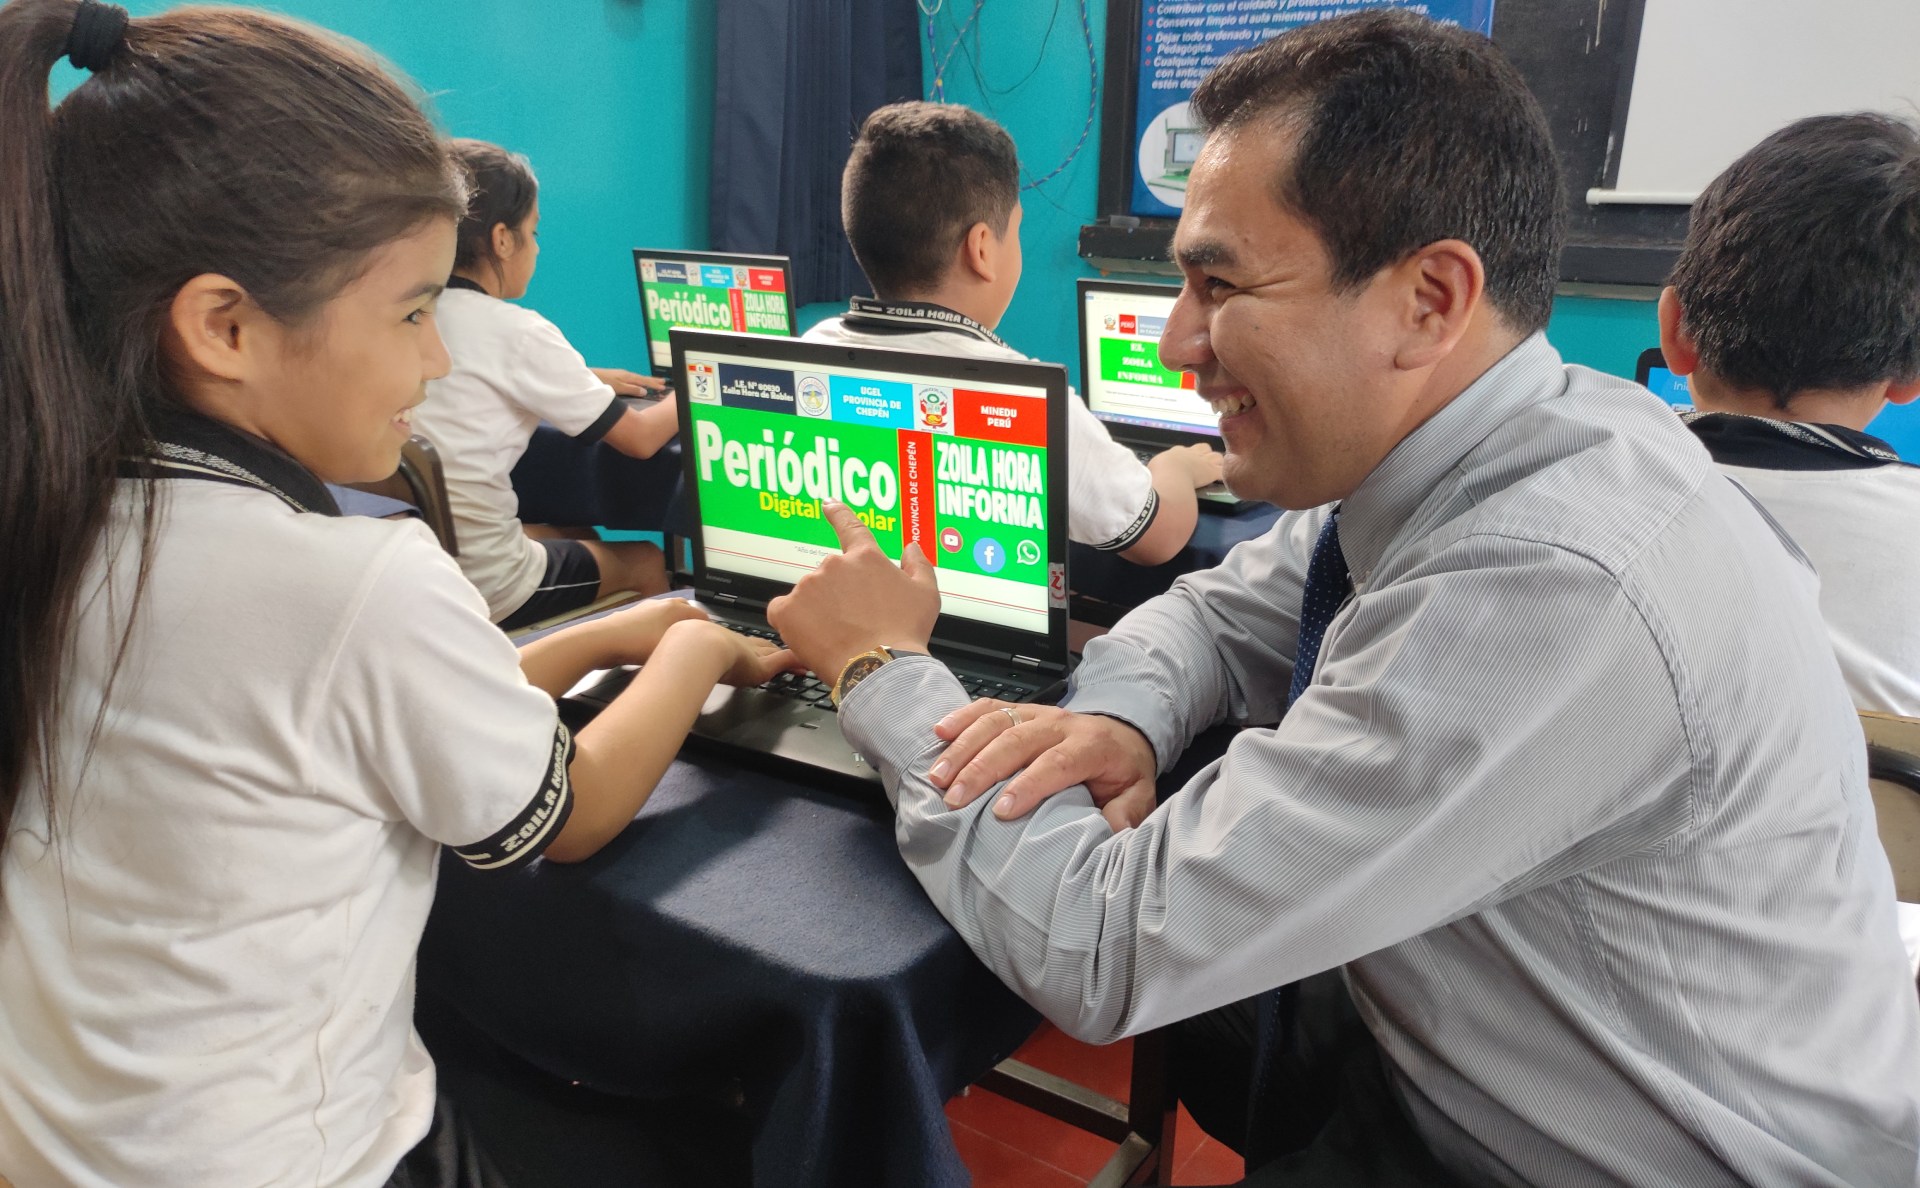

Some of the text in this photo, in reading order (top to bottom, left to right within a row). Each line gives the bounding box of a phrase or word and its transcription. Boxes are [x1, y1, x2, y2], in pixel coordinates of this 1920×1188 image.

[1157, 3, 1205, 15] Contribuir
[1206, 3, 1226, 13] con
[1226, 1, 1237, 11] el
[1237, 0, 1277, 11] cuidado
[1278, 0, 1287, 10] y
[1156, 17, 1205, 29] Conservar
[1206, 15, 1238, 28] limpio
[1238, 13, 1249, 25] el
[1249, 12, 1271, 24] aula
[1271, 10, 1318, 23] mientras
[1155, 32, 1181, 44] Dejar
[1182, 31, 1204, 42] todo
[1204, 29, 1252, 41] ordenado
[1253, 30, 1262, 41] y
[1153, 55, 1200, 68] Cualquier
[1155, 68, 1175, 78] con
[1152, 79, 1179, 90] estén
[646, 289, 731, 328] Periódico
[744, 292, 767, 314] ZOILA
[746, 312, 789, 331] INFORMA
[886, 307, 924, 318] ZOILA
[926, 310, 961, 323] HORA
[1117, 371, 1163, 385] INFORMA
[860, 386, 882, 397] UGEL
[842, 395, 902, 410] PROVINCIA DE
[856, 406, 890, 419] CHEPÉN
[980, 405, 1018, 418] MINEDU
[987, 417, 1012, 429] PERÚ
[696, 419, 898, 512] Periódico
[906, 441, 918, 480] CHEPÉN
[937, 441, 1044, 495] ZOILA HORA
[909, 481, 919, 495] DE
[759, 491, 896, 532] Digital olar
[937, 482, 1045, 531] INFORMA
[500, 789, 558, 852] ZOILA
